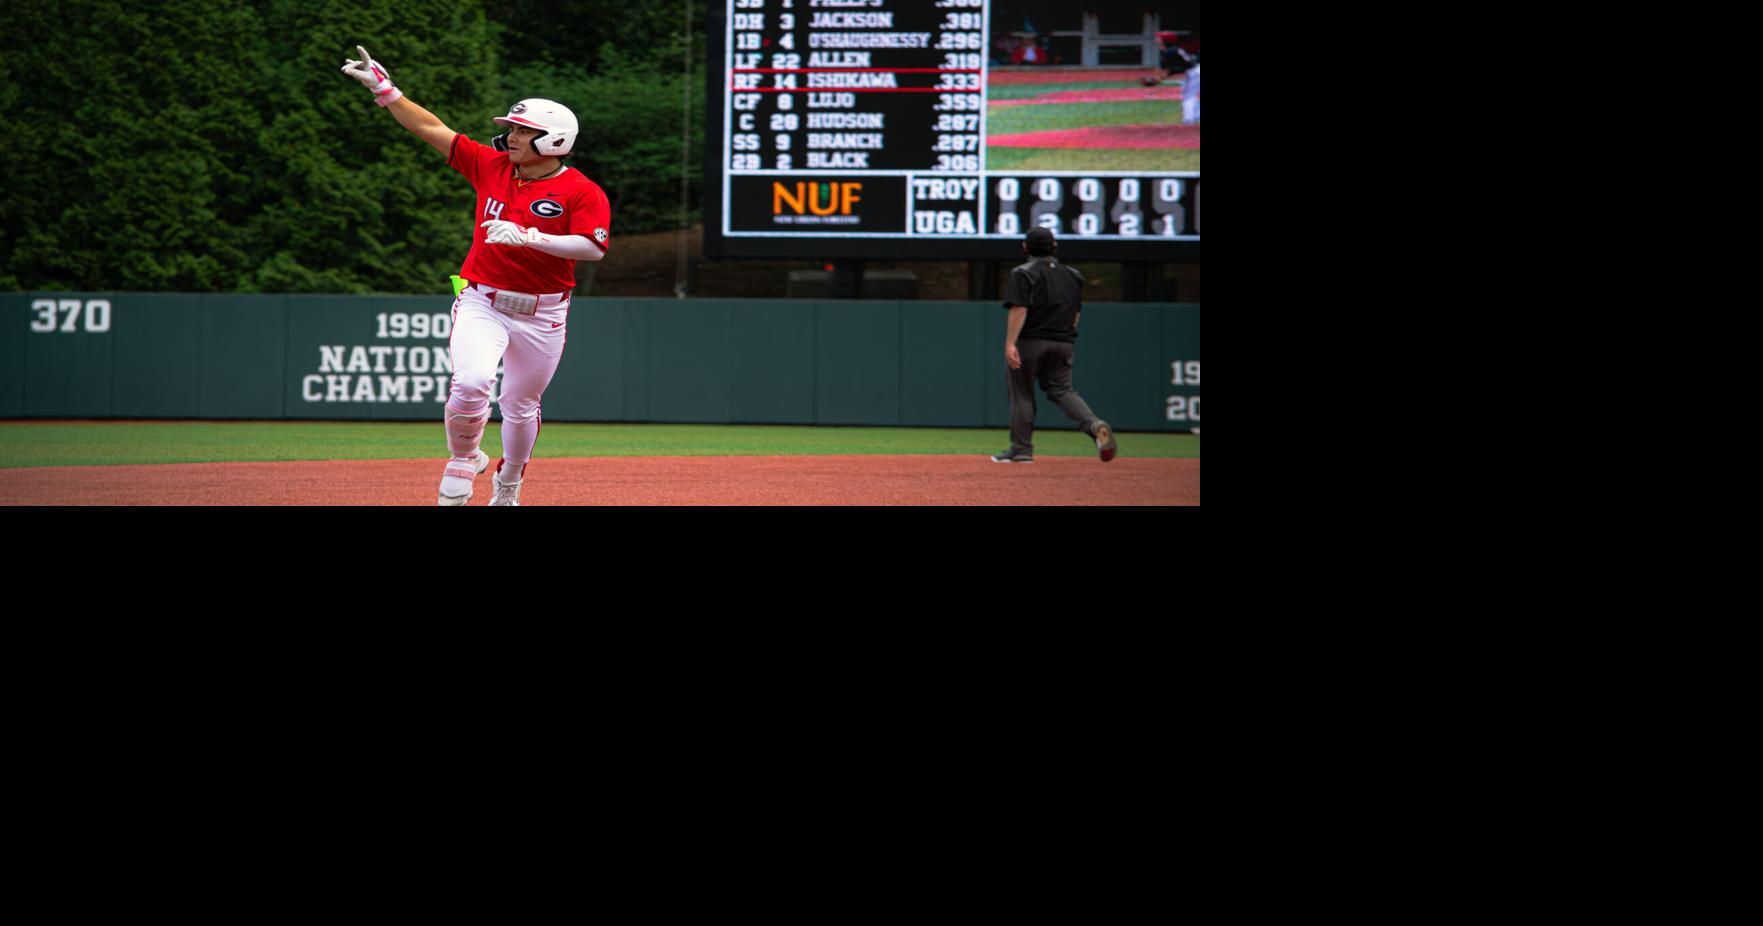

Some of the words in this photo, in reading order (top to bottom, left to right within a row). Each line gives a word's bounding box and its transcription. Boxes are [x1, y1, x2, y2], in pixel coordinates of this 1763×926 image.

[735, 13, 764, 30] DH
[779, 13, 795, 30] 3
[808, 12, 893, 28] JACKSON
[737, 33, 762, 49] 1B
[778, 33, 795, 49] 4
[934, 33, 981, 50] .296
[735, 53, 762, 69] LF
[772, 53, 800, 69] 22
[807, 52, 870, 67] ALLEN
[734, 74, 762, 89] RF
[773, 74, 797, 89] 14
[807, 73, 896, 88] ISHIKAWA
[934, 74, 980, 90] .333
[734, 94, 762, 110] CF
[933, 94, 980, 111] .359
[739, 114, 755, 131] C
[806, 113, 884, 129] HUDSON
[733, 134, 760, 150] SS
[775, 134, 791, 150] 9
[806, 133, 883, 149] BRANCH
[732, 154, 760, 169] 2B
[776, 154, 791, 169] 2
[806, 152, 869, 168] BLACK
[931, 154, 979, 170] .306
[773, 181, 862, 215] NUF
[914, 178, 979, 201] TROY
[998, 178, 1019, 201] 0
[1038, 178, 1059, 201] 0
[1078, 178, 1100, 201] 0
[1119, 179, 1140, 202] 0
[1160, 179, 1179, 202] 0
[484, 197, 505, 221] 14
[914, 210, 976, 234] UGA
[998, 212, 1019, 235] 0
[1078, 213, 1098, 235] 0
[1119, 213, 1139, 236] 2
[1162, 214, 1176, 236] 1
[31, 299, 111, 332] 370
[376, 312, 451, 338] 1990
[319, 345, 452, 374] NATION
[302, 374, 452, 402] CHAMPI
